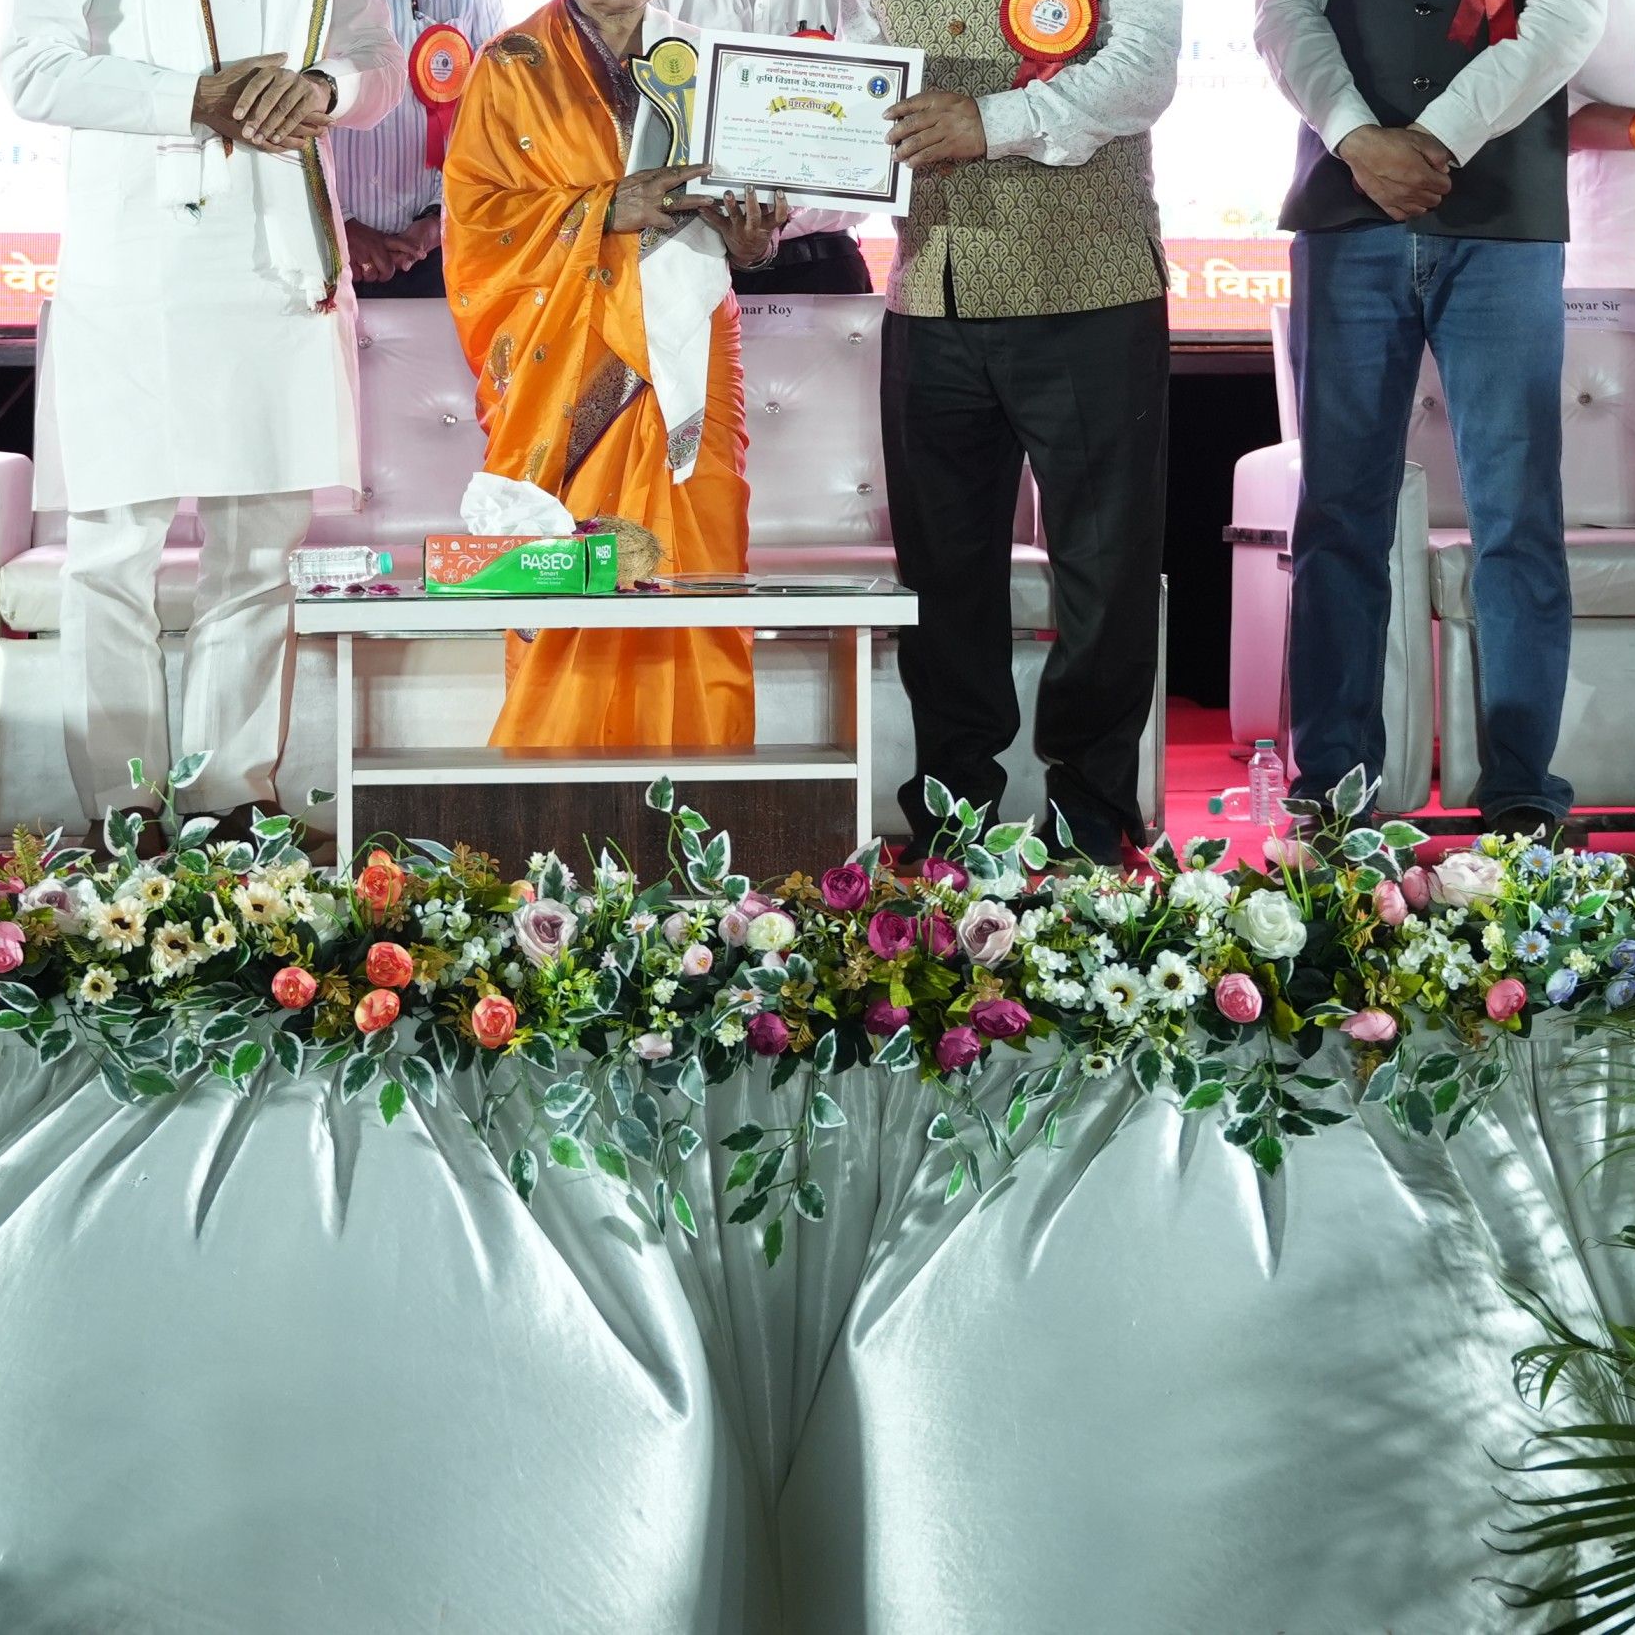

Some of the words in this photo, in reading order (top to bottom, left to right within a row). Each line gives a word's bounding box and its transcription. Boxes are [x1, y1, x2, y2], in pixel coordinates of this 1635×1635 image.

[1203, 257, 1292, 304] विज्ञा
[768, 303, 793, 317] Roy
[1602, 300, 1621, 312] Sir
[520, 552, 574, 570] PASEO
